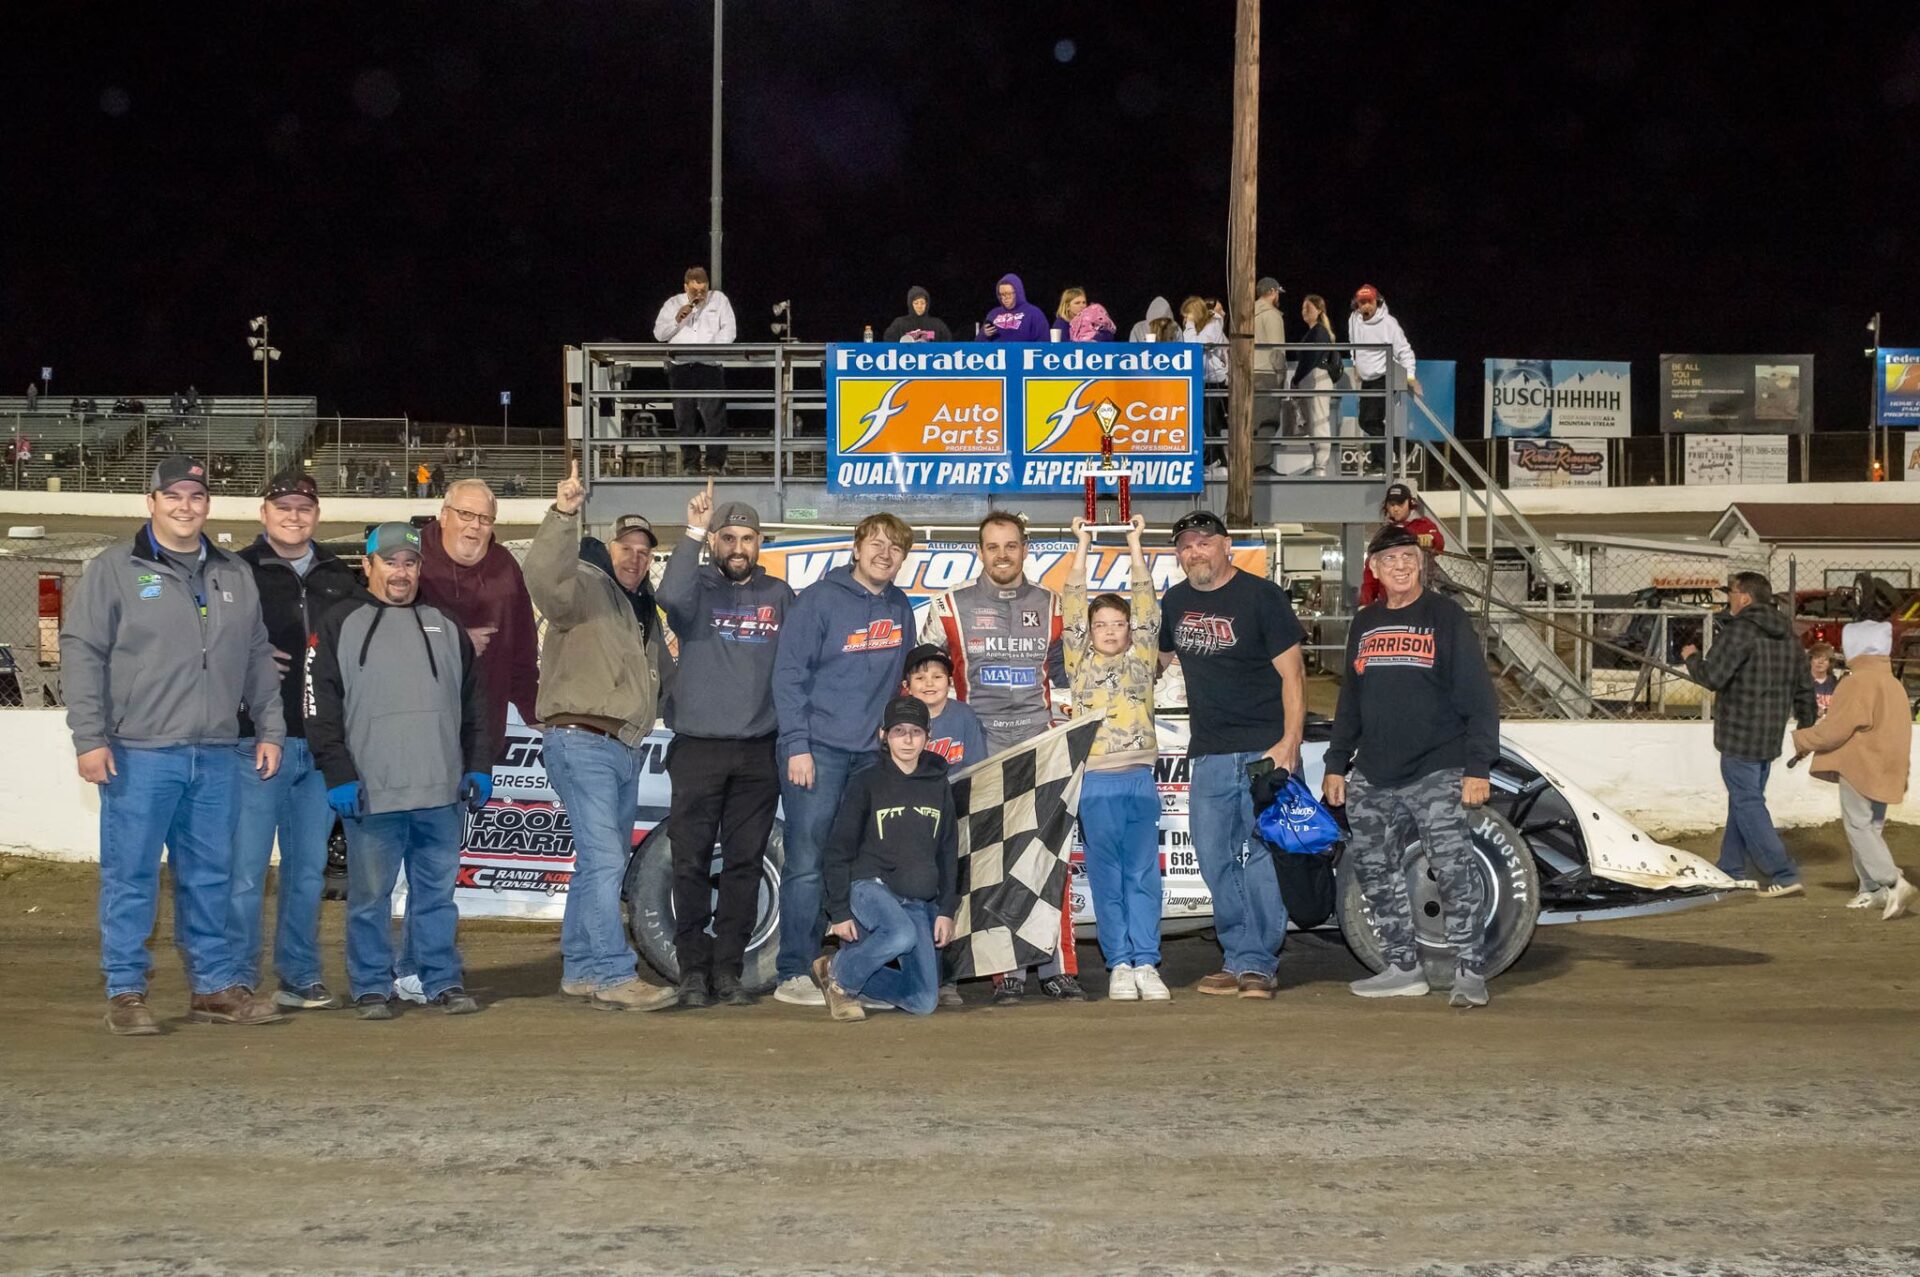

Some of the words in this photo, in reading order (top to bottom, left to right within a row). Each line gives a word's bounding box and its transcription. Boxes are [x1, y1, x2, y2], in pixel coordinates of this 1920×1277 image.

[836, 349, 1006, 370] Federated
[1023, 349, 1193, 370] Federated
[1493, 386, 1621, 411] BUSCHHHHHH
[932, 403, 999, 423] Auto
[1126, 401, 1185, 422] Car
[922, 425, 1000, 444] Parts
[1110, 424, 1185, 444] Care
[837, 462, 935, 487] QUALITY
[936, 462, 1010, 486] PARTS
[1104, 461, 1195, 486] SRVICE
[1029, 543, 1091, 551] ASSOCIATI
[1085, 552, 1190, 591] LAN
[985, 636, 1046, 652] KLEIN'S
[492, 774, 554, 789] GRESSI
[472, 808, 572, 831] FOOD
[1279, 819, 1310, 832] CLUB
[468, 829, 573, 852] MART
[1170, 852, 1197, 866] 618-
[1472, 816, 1528, 902] Hoosier
[496, 869, 544, 880] RANDY
